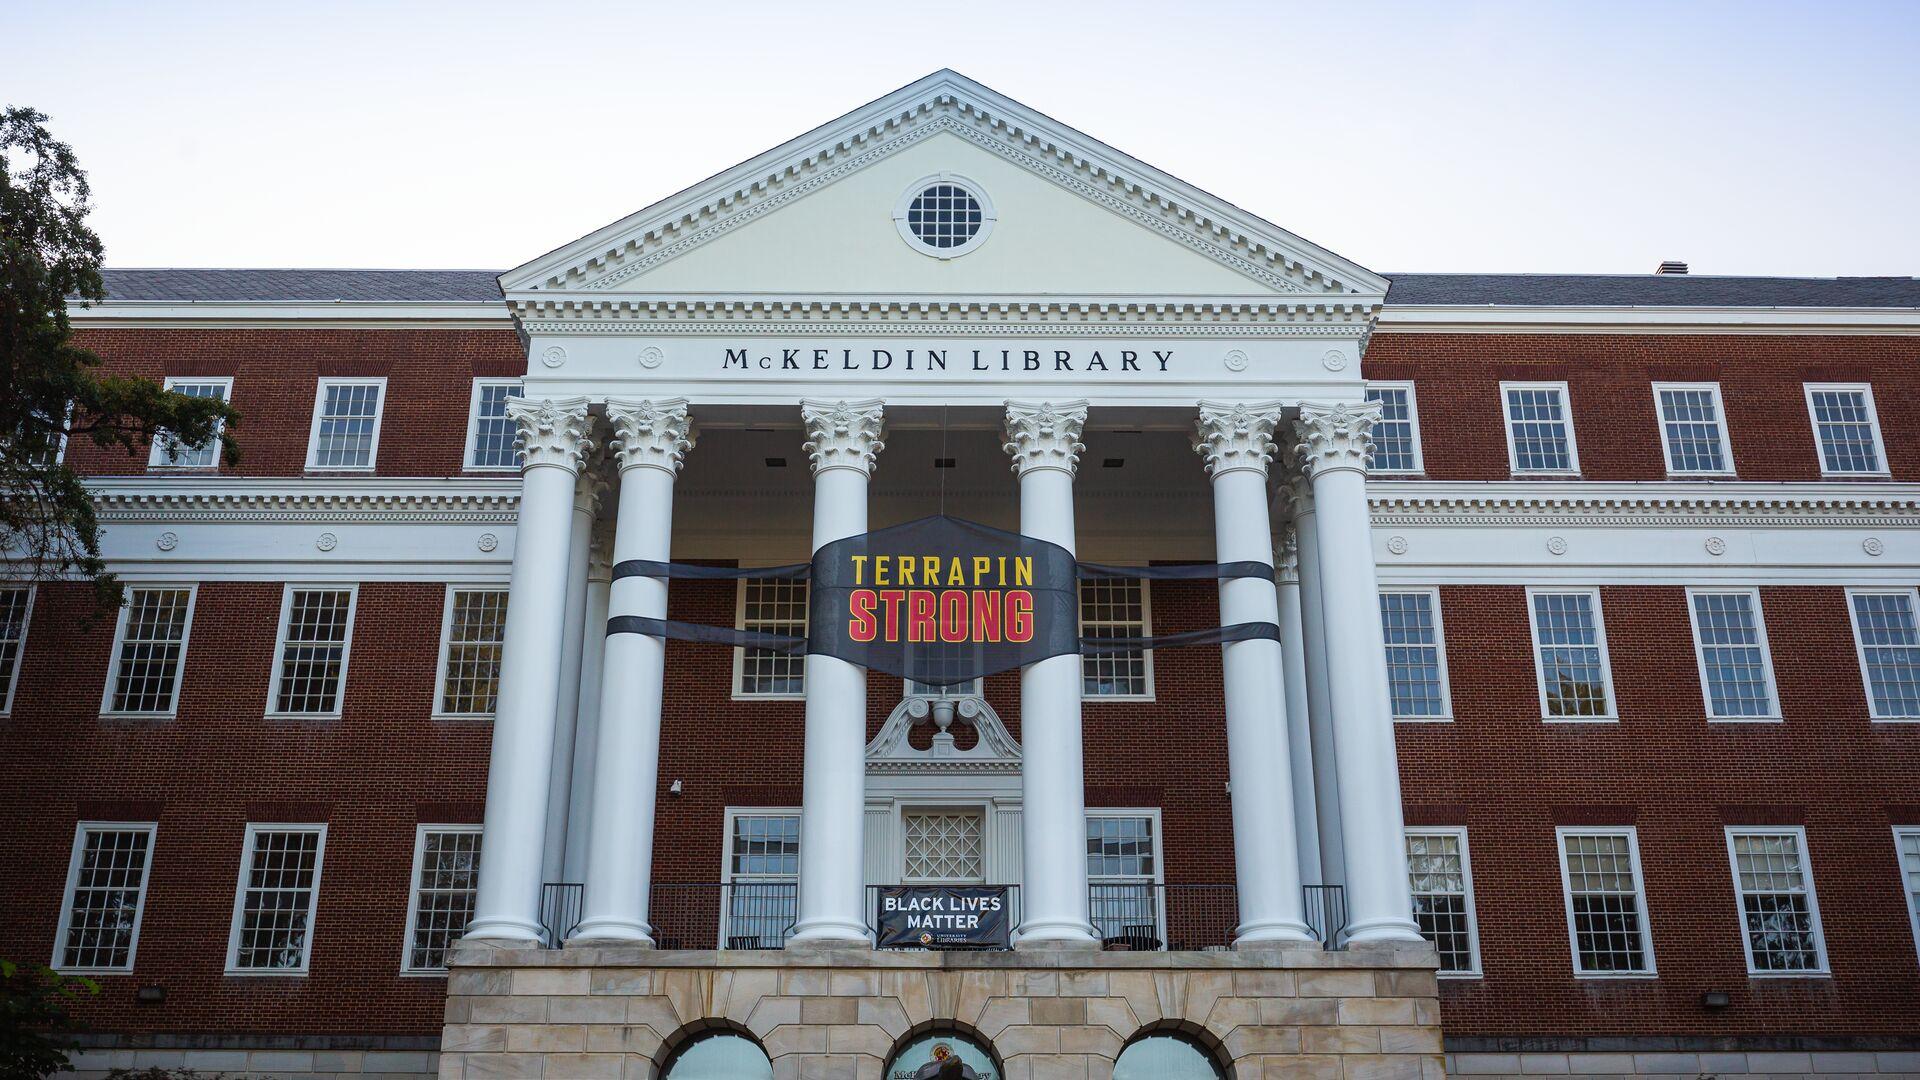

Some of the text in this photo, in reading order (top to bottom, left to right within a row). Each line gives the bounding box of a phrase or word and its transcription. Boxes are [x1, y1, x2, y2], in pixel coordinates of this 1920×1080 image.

[973, 351, 1174, 372] LIBRARY
[852, 556, 1033, 586] TERRAPIN
[849, 589, 1034, 642] STRONG
[885, 897, 1001, 911] BLACK LIVES
[907, 914, 979, 929] MATTER
